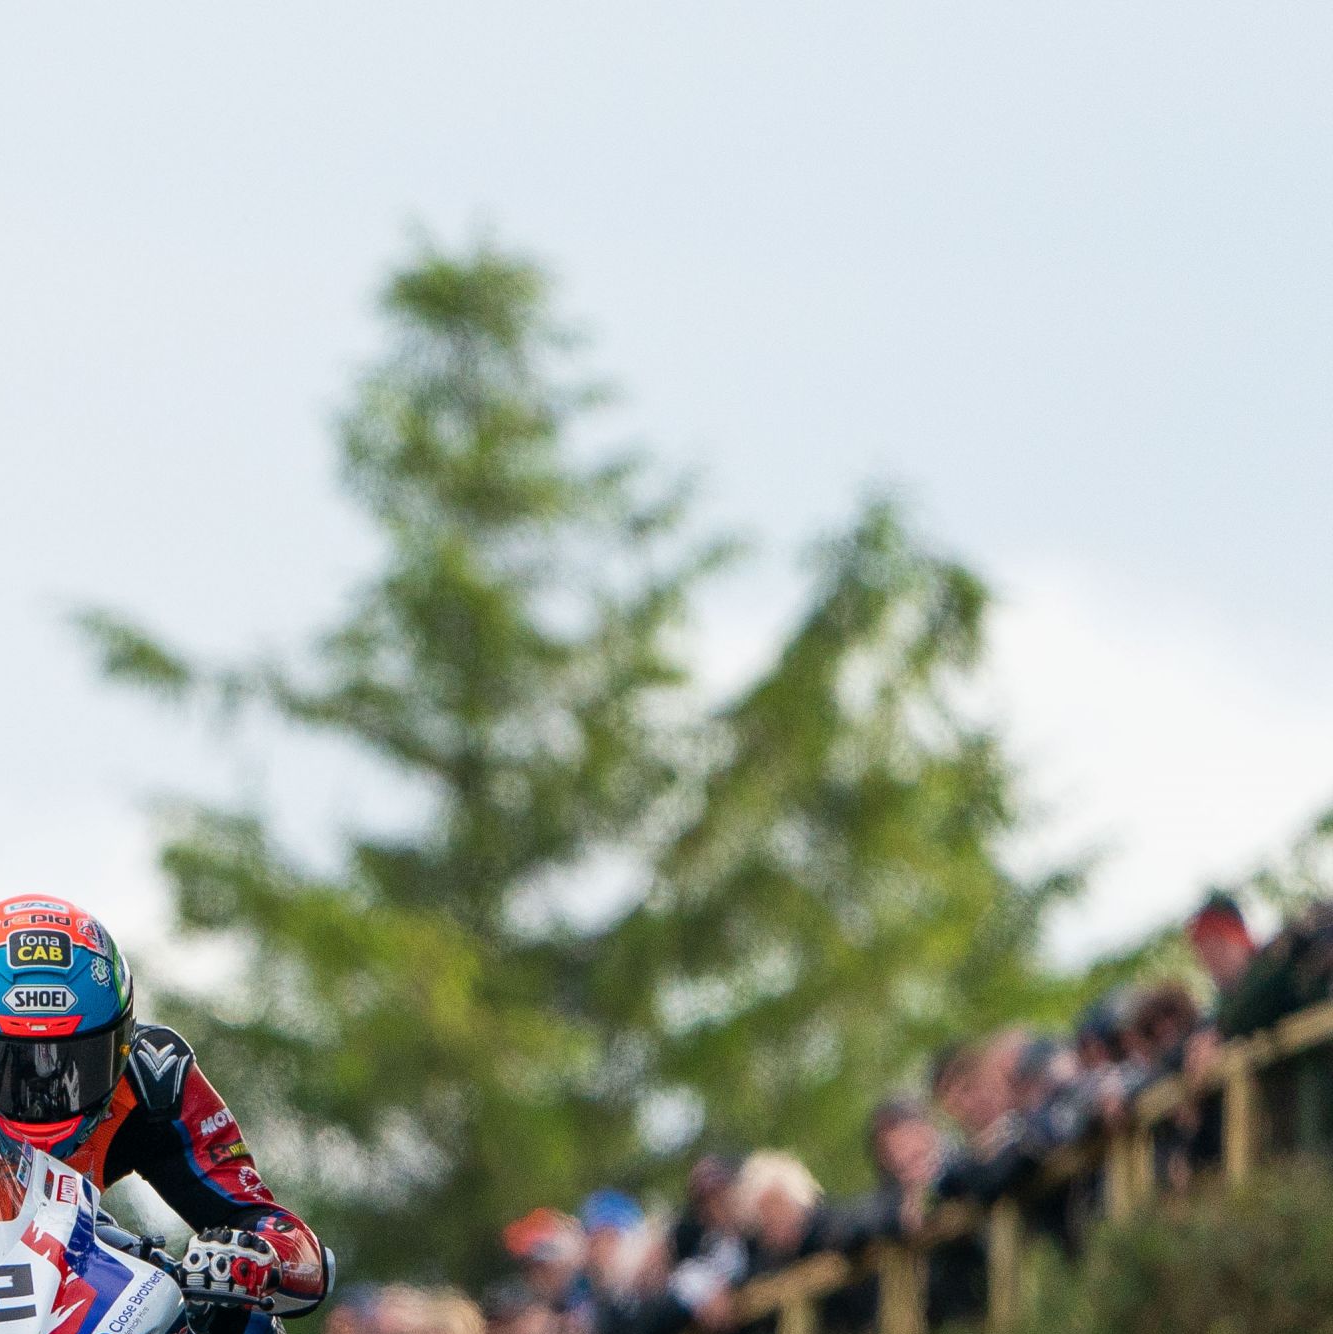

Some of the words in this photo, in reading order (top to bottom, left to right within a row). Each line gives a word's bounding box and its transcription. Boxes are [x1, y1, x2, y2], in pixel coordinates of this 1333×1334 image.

[19, 933, 60, 946] fona
[17, 947, 63, 961] CAB
[14, 990, 67, 1008] SHOEI
[200, 1107, 233, 1136] MOT
[109, 1304, 137, 1333] Close
[128, 1270, 166, 1305] Brothers
